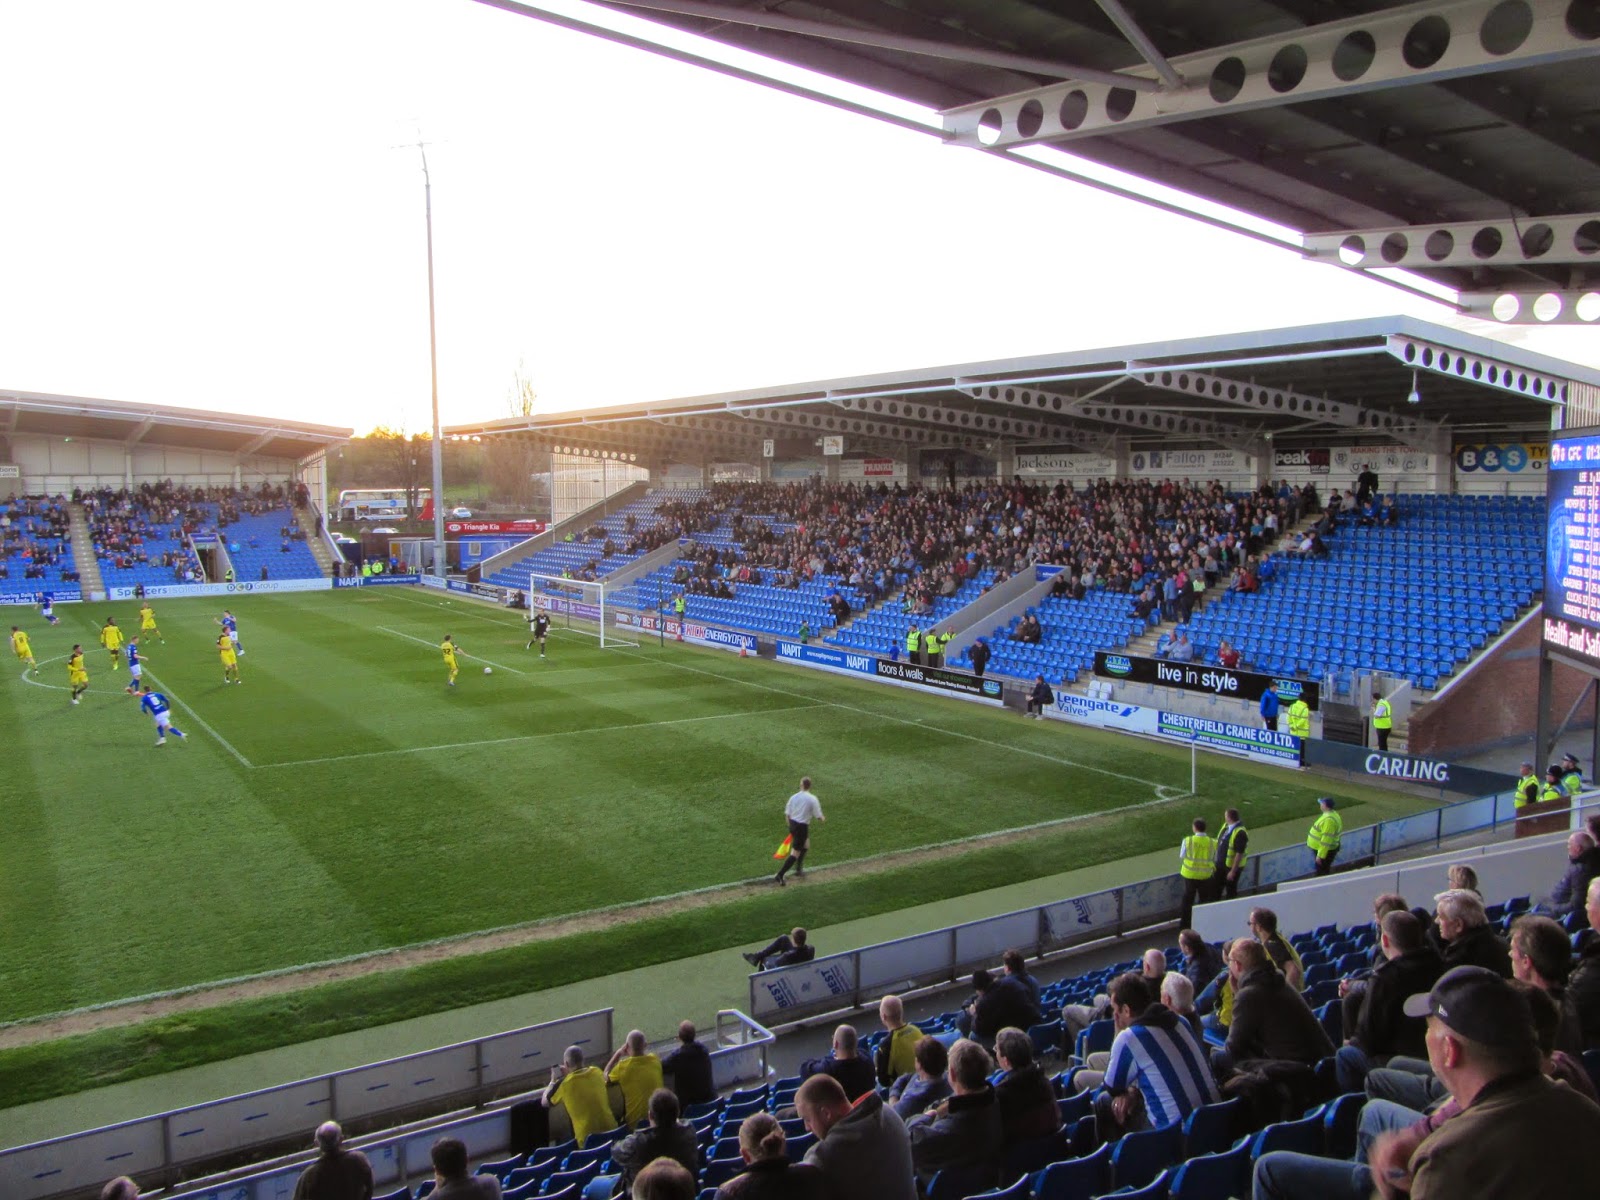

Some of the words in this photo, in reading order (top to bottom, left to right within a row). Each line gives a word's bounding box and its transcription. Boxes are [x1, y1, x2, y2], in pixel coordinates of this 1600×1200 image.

[1166, 452, 1205, 464] Fallon
[117, 588, 167, 597] Specers
[339, 577, 365, 587] NAPIT
[632, 614, 641, 628] sky
[642, 616, 654, 629] BET
[667, 620, 678, 633] BET
[686, 624, 705, 639] KICK
[1544, 619, 1568, 647] Health
[1569, 628, 1585, 653] and
[782, 643, 802, 658] NAPIT
[846, 655, 870, 671] NAPIT
[1107, 655, 1130, 665] HTM
[878, 662, 898, 676] floors
[898, 666, 904, 677] &
[905, 669, 924, 681] walls
[1158, 663, 1182, 682] live
[1186, 667, 1198, 685] in
[1202, 672, 1238, 693] style
[1057, 692, 1119, 714] Leengate
[1057, 702, 1088, 717] Valves
[1163, 712, 1224, 734] CHESTERFIELD
[1226, 724, 1257, 741] CRANE
[1259, 730, 1272, 744] CO
[1274, 733, 1295, 749] LTD.
[1163, 728, 1191, 739] OVERHEAD
[1211, 738, 1248, 750] SPECIALISTS
[1365, 753, 1448, 782] CARLING
[821, 970, 841, 995] BEST
[767, 984, 788, 1008] BEST
